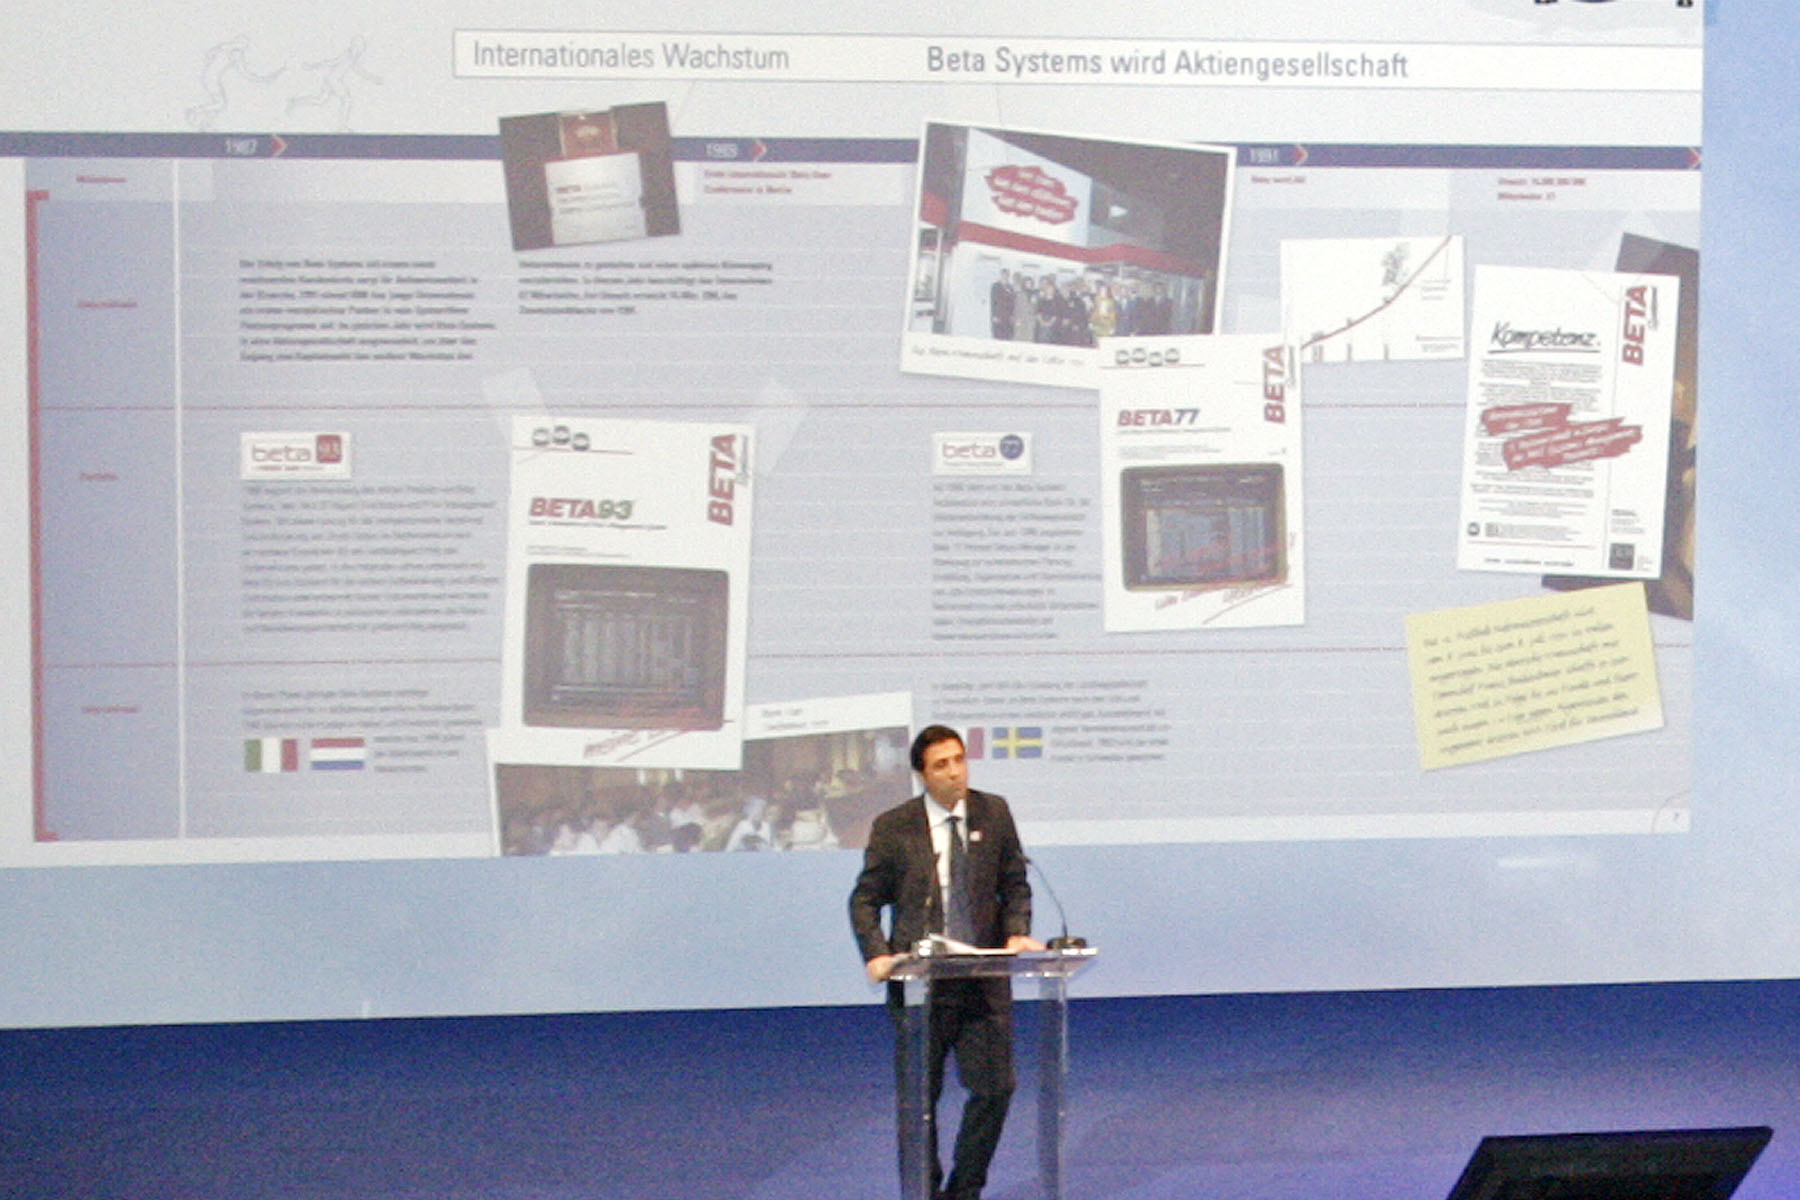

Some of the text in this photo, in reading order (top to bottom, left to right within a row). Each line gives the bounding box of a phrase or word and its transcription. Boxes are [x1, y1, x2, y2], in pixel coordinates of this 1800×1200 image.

[473, 41, 789, 69] Internationales Wachstum
[926, 45, 1409, 81] Beta Systems wird Aktiengesellschaft
[1622, 284, 1649, 367] BETA
[1262, 345, 1287, 425] BETA
[1116, 408, 1201, 427] BETA77
[251, 445, 312, 462] beta
[942, 443, 997, 458] beta
[706, 432, 737, 527] BETA
[529, 496, 634, 520] BETA93
